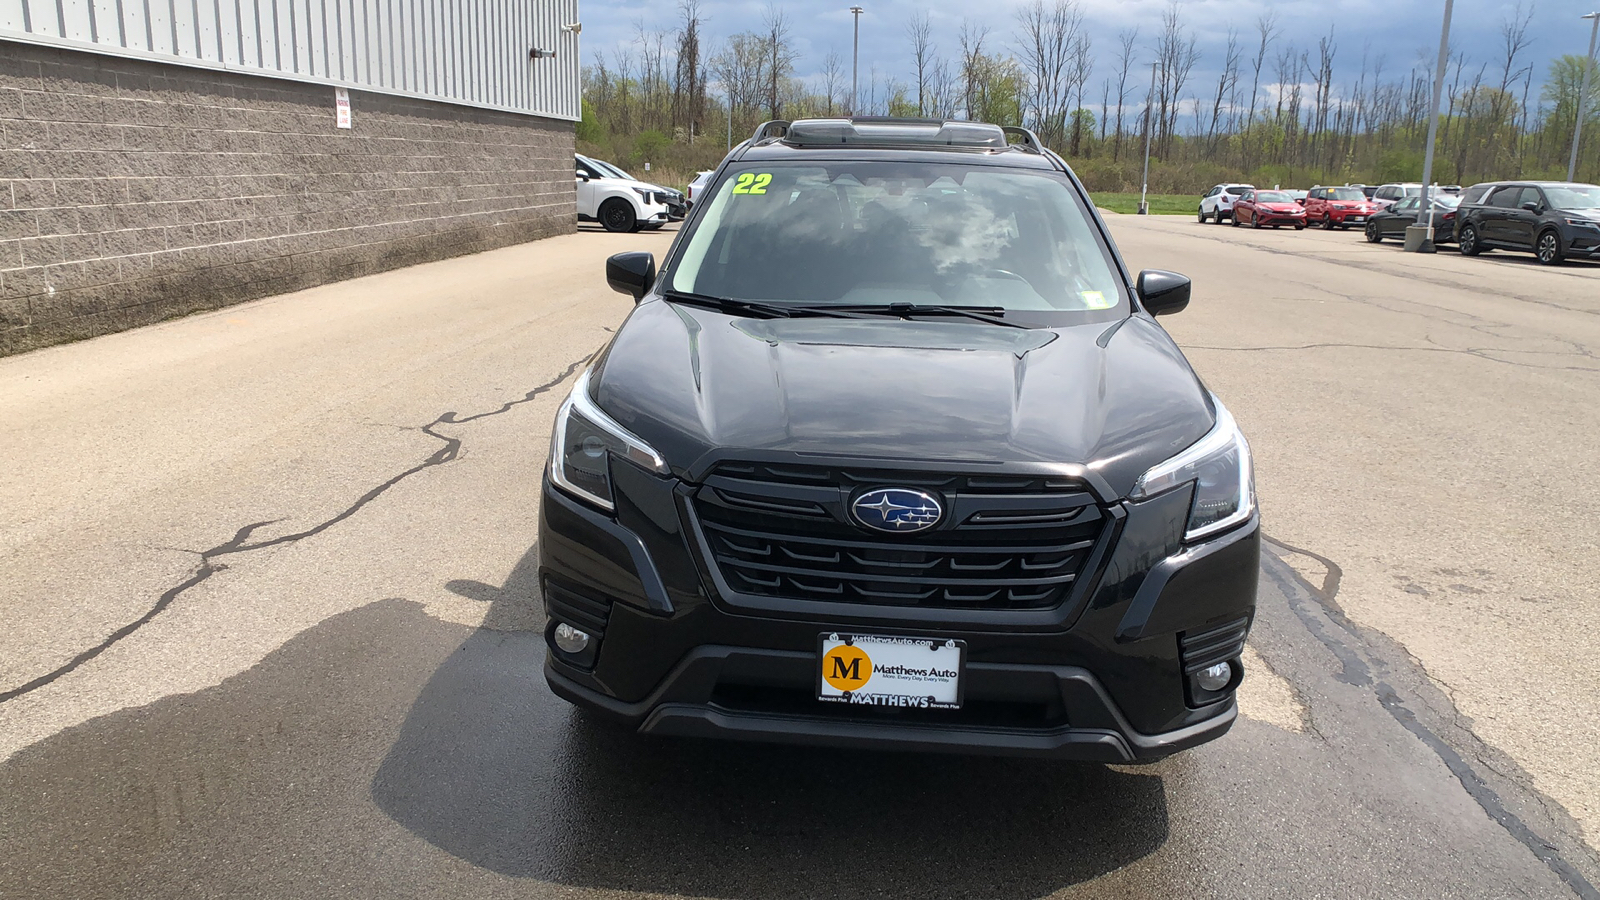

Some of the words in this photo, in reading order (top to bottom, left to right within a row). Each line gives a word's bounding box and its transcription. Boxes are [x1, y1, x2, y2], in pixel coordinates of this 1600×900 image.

[732, 173, 773, 195] 22
[851, 635, 934, 647] MatthewsAuto.com
[829, 656, 863, 680] M
[873, 664, 928, 676] Matthews
[928, 668, 958, 678] Auto
[850, 692, 929, 708] MATTHEWS
